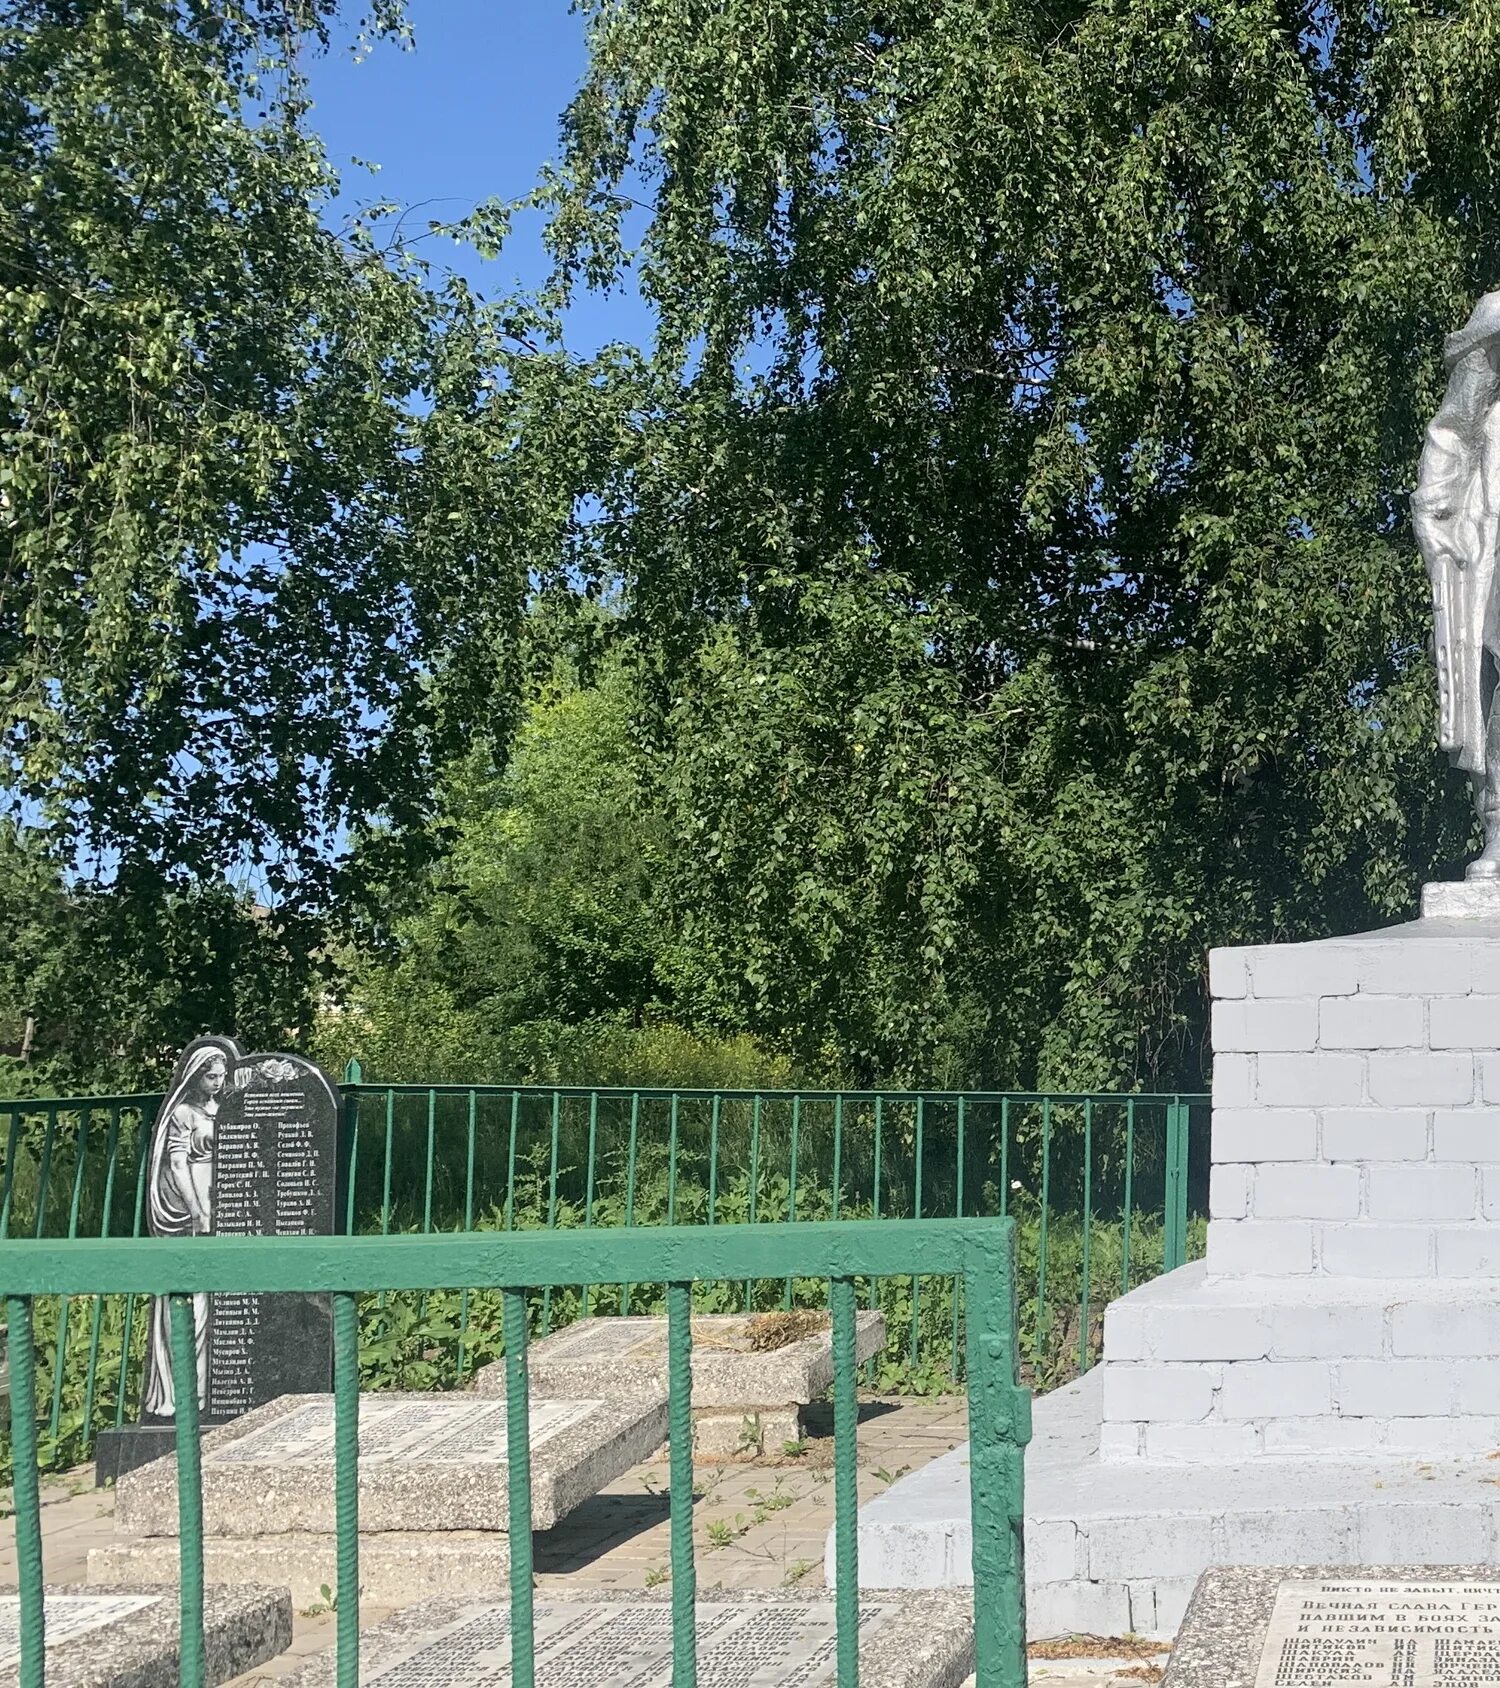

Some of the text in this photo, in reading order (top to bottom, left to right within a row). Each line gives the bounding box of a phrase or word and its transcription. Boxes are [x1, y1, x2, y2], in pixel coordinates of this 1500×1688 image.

[1300, 1613, 1386, 1621] ПАВШИМ
[1419, 1614, 1469, 1622] БОЯХ
[1321, 1624, 1493, 1634] НЕЗАВИСИМОСТЬ
